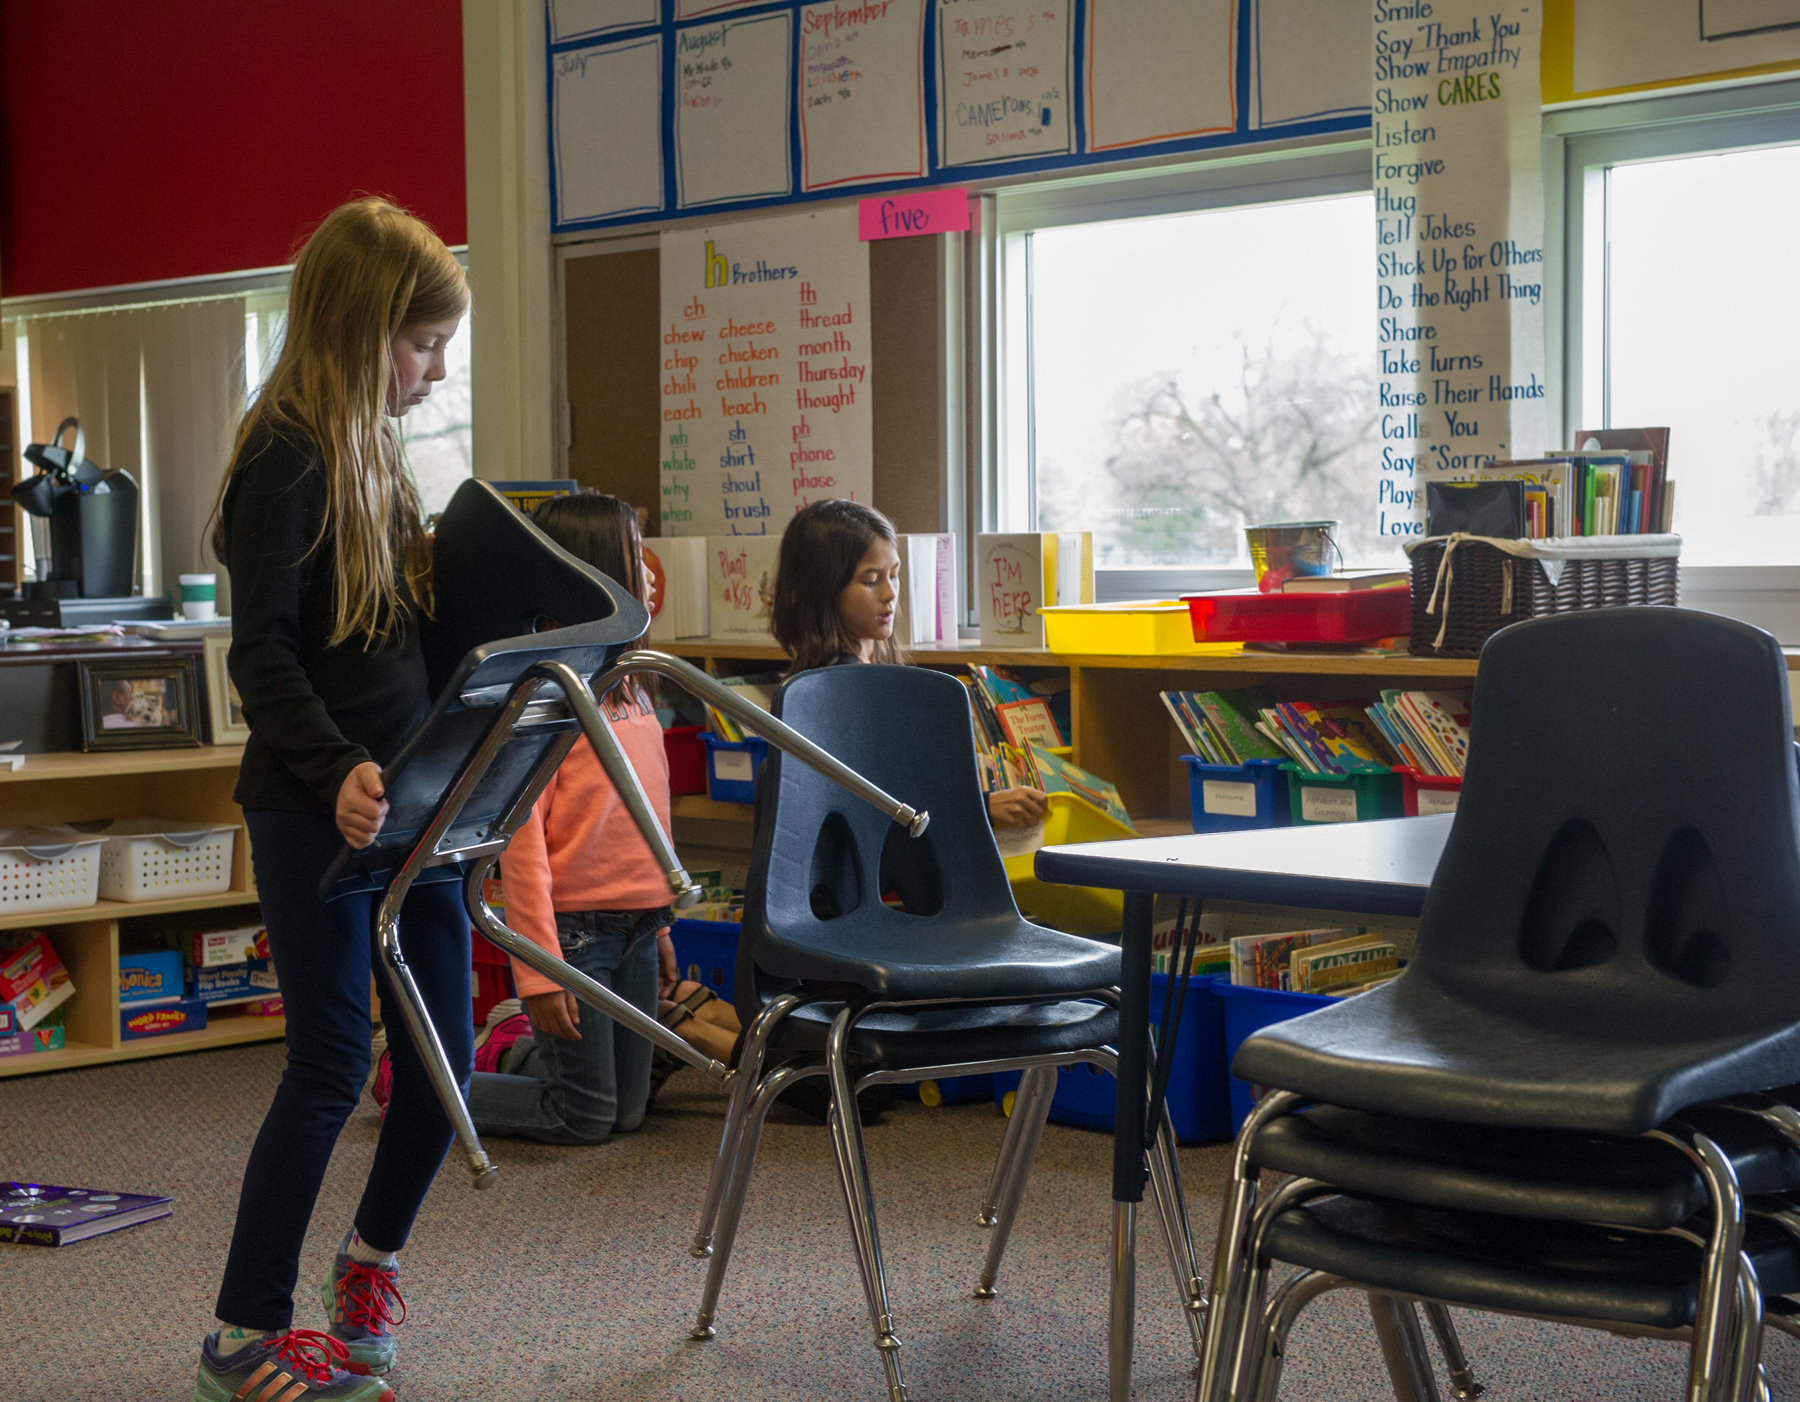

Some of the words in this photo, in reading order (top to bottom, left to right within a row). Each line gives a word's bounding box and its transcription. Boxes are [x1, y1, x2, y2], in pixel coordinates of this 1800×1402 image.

[803, 0, 894, 38] September
[1374, 0, 1434, 23] Smile
[679, 23, 727, 58] August
[1376, 30, 1413, 60] Say
[557, 54, 589, 78] July
[1375, 54, 1430, 81] Show
[1438, 40, 1521, 77] Empathy
[1375, 88, 1429, 114] Show
[1437, 72, 1501, 106] CARES
[1376, 119, 1436, 148] Listen
[1376, 153, 1446, 185] Forgive
[1376, 187, 1416, 218] Hug
[880, 200, 930, 233] five
[1376, 216, 1412, 245] Tell
[1420, 213, 1476, 241] Jokes
[705, 240, 728, 289] h
[732, 260, 799, 285] Brothers
[1377, 250, 1426, 278] Stick
[1432, 248, 1457, 279] Up
[1461, 244, 1487, 271] for
[1490, 240, 1543, 268] Others
[799, 281, 817, 302] th
[1378, 284, 1402, 309] Do
[1409, 282, 1440, 308] the
[1444, 275, 1491, 312] Right
[1497, 273, 1542, 305] Thing
[683, 295, 706, 318] ch
[799, 302, 853, 328] thread
[664, 324, 705, 345] chew
[719, 318, 776, 339] cheese
[1379, 317, 1438, 343] Share
[718, 341, 779, 365] chicken
[799, 331, 851, 356] month
[664, 349, 699, 373] chip
[797, 356, 866, 383] Thursday
[1380, 349, 1421, 375] Take
[1428, 346, 1484, 372] Turns
[664, 373, 697, 396] chili
[716, 366, 780, 391] children
[1379, 382, 1428, 407] Raise
[1432, 378, 1484, 405] Their
[1489, 373, 1545, 402] Hands
[664, 399, 702, 421] each
[721, 391, 767, 416] teach
[796, 383, 857, 414] thought
[669, 424, 688, 446] wh
[728, 420, 746, 442] sh
[792, 414, 811, 443] ph
[1444, 410, 1479, 438] You
[720, 445, 755, 469] shirt
[790, 441, 836, 471] phone
[662, 475, 690, 501] why
[722, 471, 761, 494] shout
[793, 467, 837, 496] phase
[662, 500, 693, 522] when
[724, 497, 771, 519] brush
[1380, 511, 1425, 536] Love
[718, 547, 748, 579] Plant
[732, 579, 753, 611] Kiss
[1010, 714, 1027, 726] The
[1026, 711, 1046, 723] Farm
[1018, 723, 1047, 736] Tractor
[119, 970, 163, 992] honics
[128, 1012, 153, 1029] WORD
[156, 1010, 187, 1023] FAMILY
